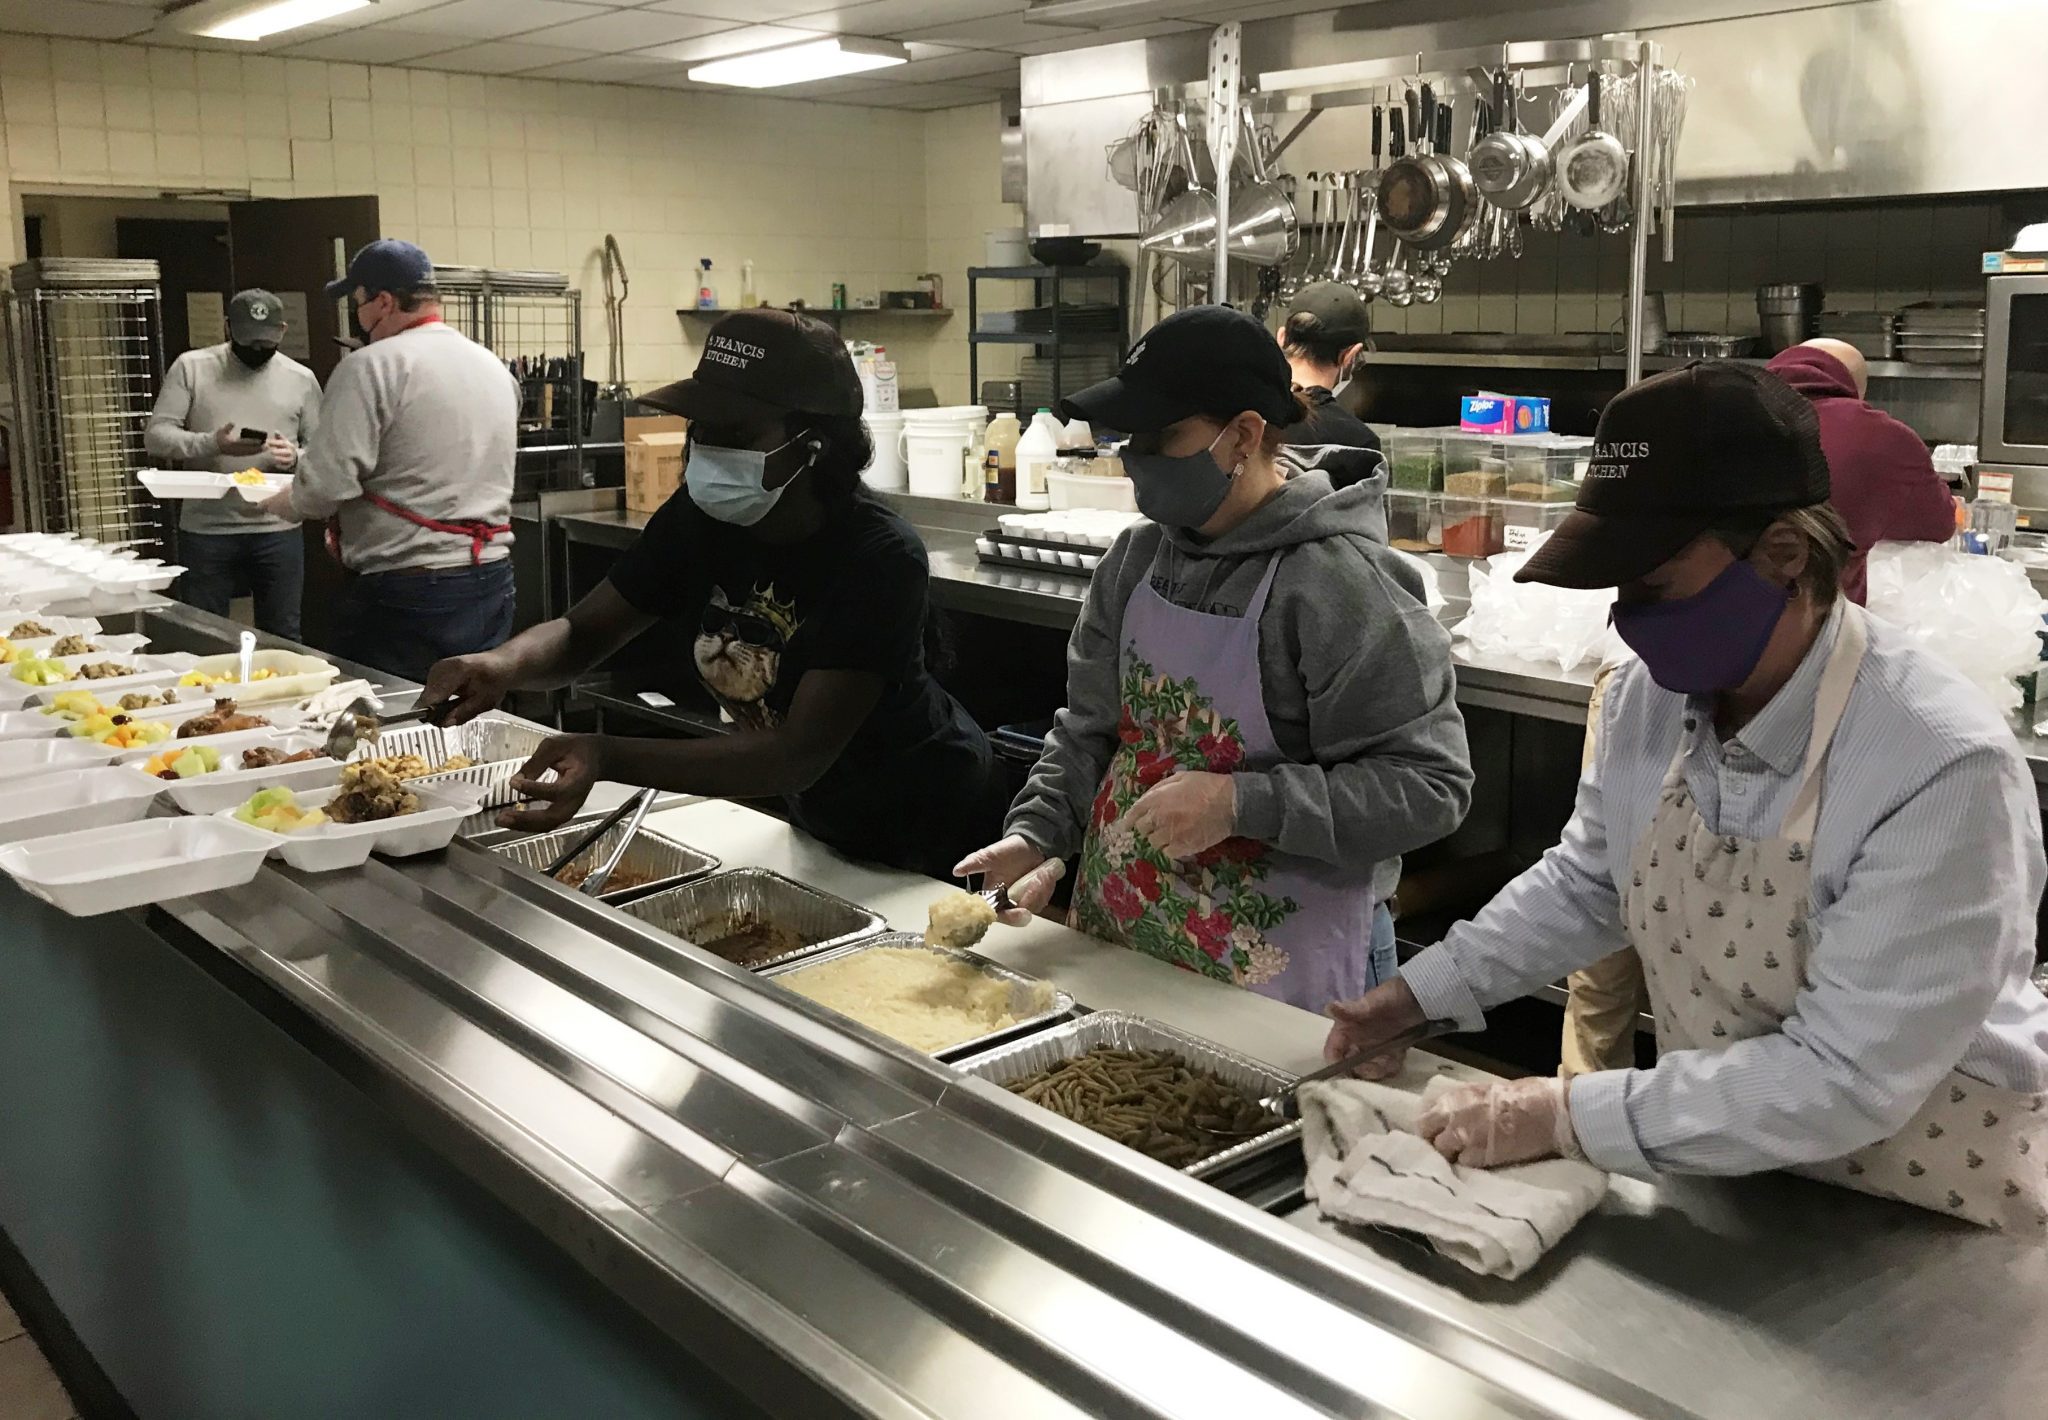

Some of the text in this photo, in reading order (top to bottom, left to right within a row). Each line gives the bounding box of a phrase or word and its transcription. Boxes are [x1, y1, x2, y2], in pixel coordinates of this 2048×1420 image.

[704, 349, 749, 369] ITCHEN
[1469, 399, 1495, 413] Ziploc
[1594, 442, 1650, 458] RANCIS
